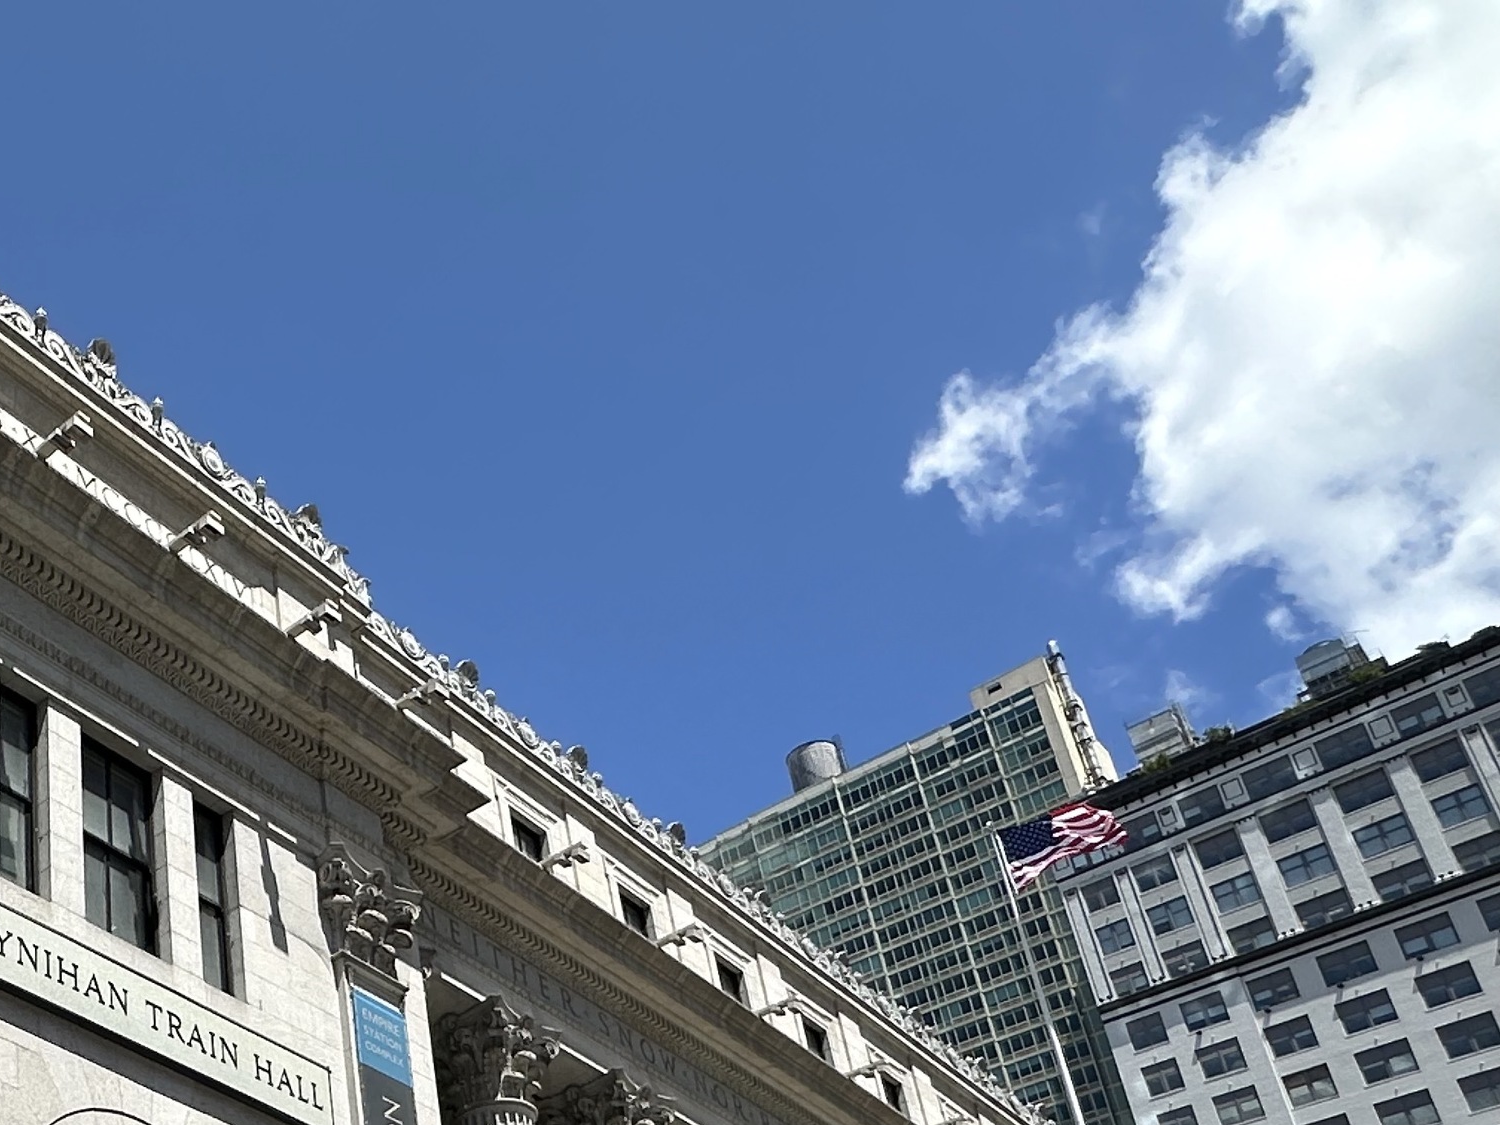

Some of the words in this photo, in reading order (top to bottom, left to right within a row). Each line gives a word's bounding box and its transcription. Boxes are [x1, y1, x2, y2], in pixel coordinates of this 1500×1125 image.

[361, 1007, 401, 1037] EMPIRE
[421, 904, 588, 1018] NEITHER
[598, 1012, 677, 1077] SNOW
[144, 999, 239, 1071] TRAIN
[252, 1052, 324, 1112] HALL
[363, 1024, 402, 1053] STATION
